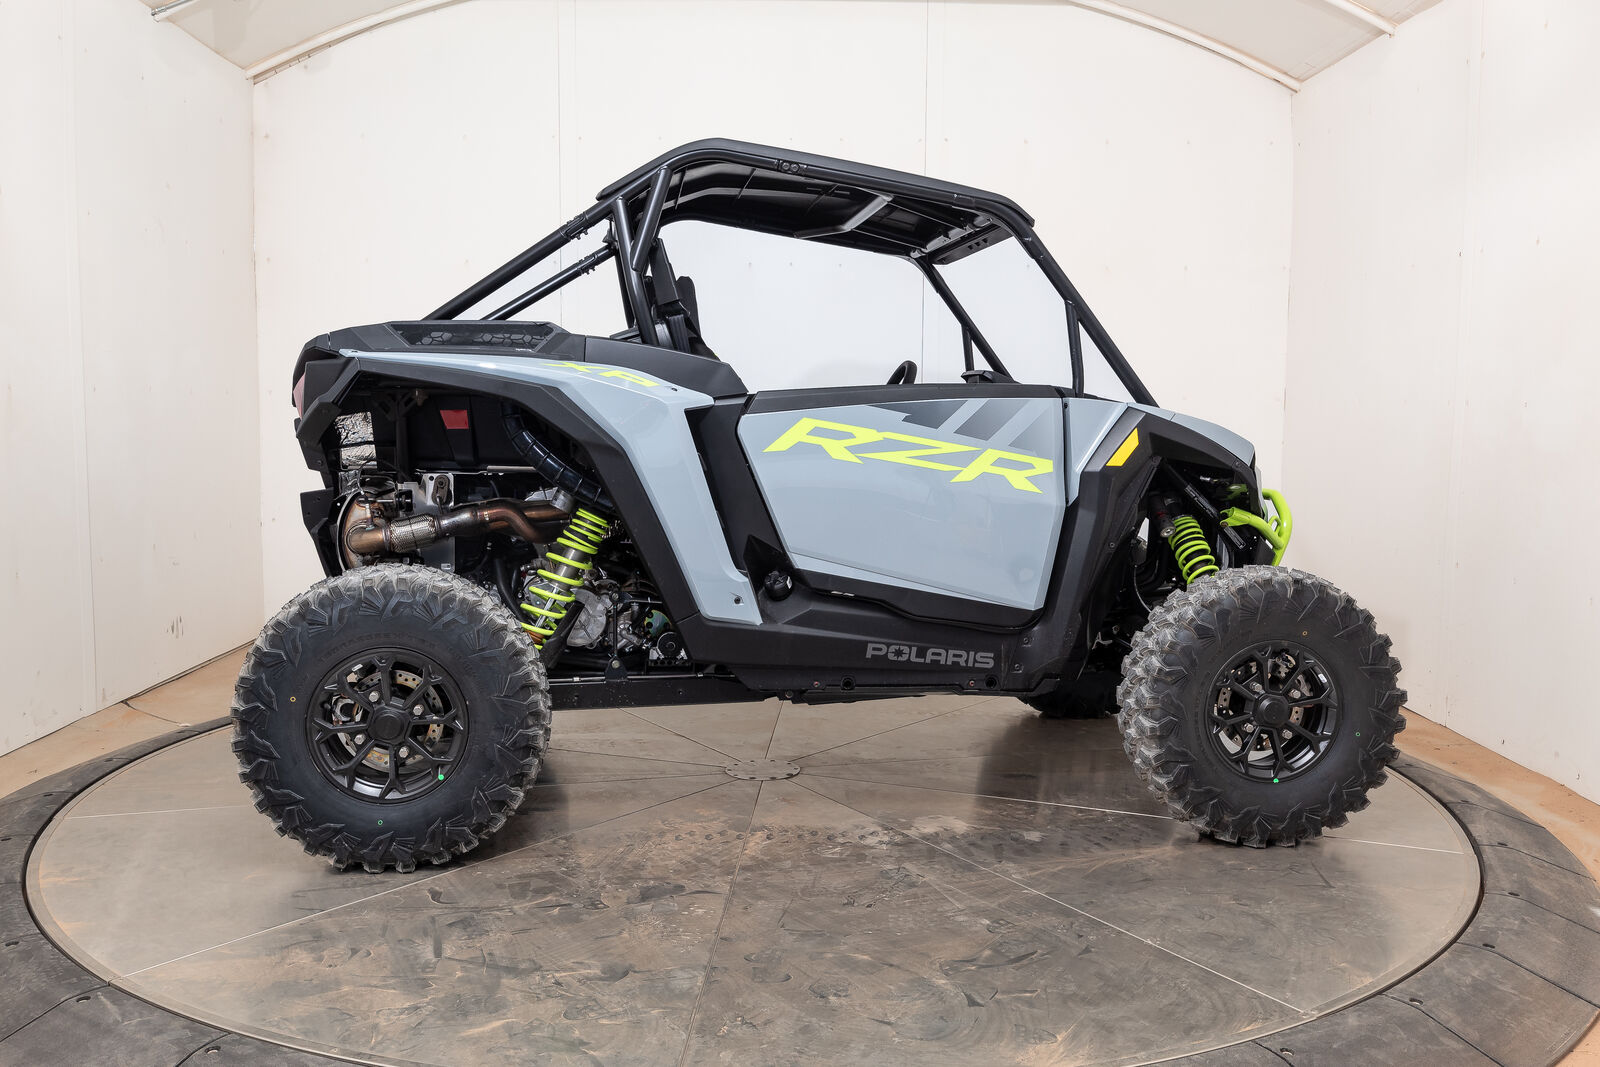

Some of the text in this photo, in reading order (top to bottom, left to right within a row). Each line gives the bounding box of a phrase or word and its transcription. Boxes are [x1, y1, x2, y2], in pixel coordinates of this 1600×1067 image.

[541, 361, 660, 387] XP
[763, 417, 1053, 494] RZR
[865, 643, 995, 669] POLARIS
